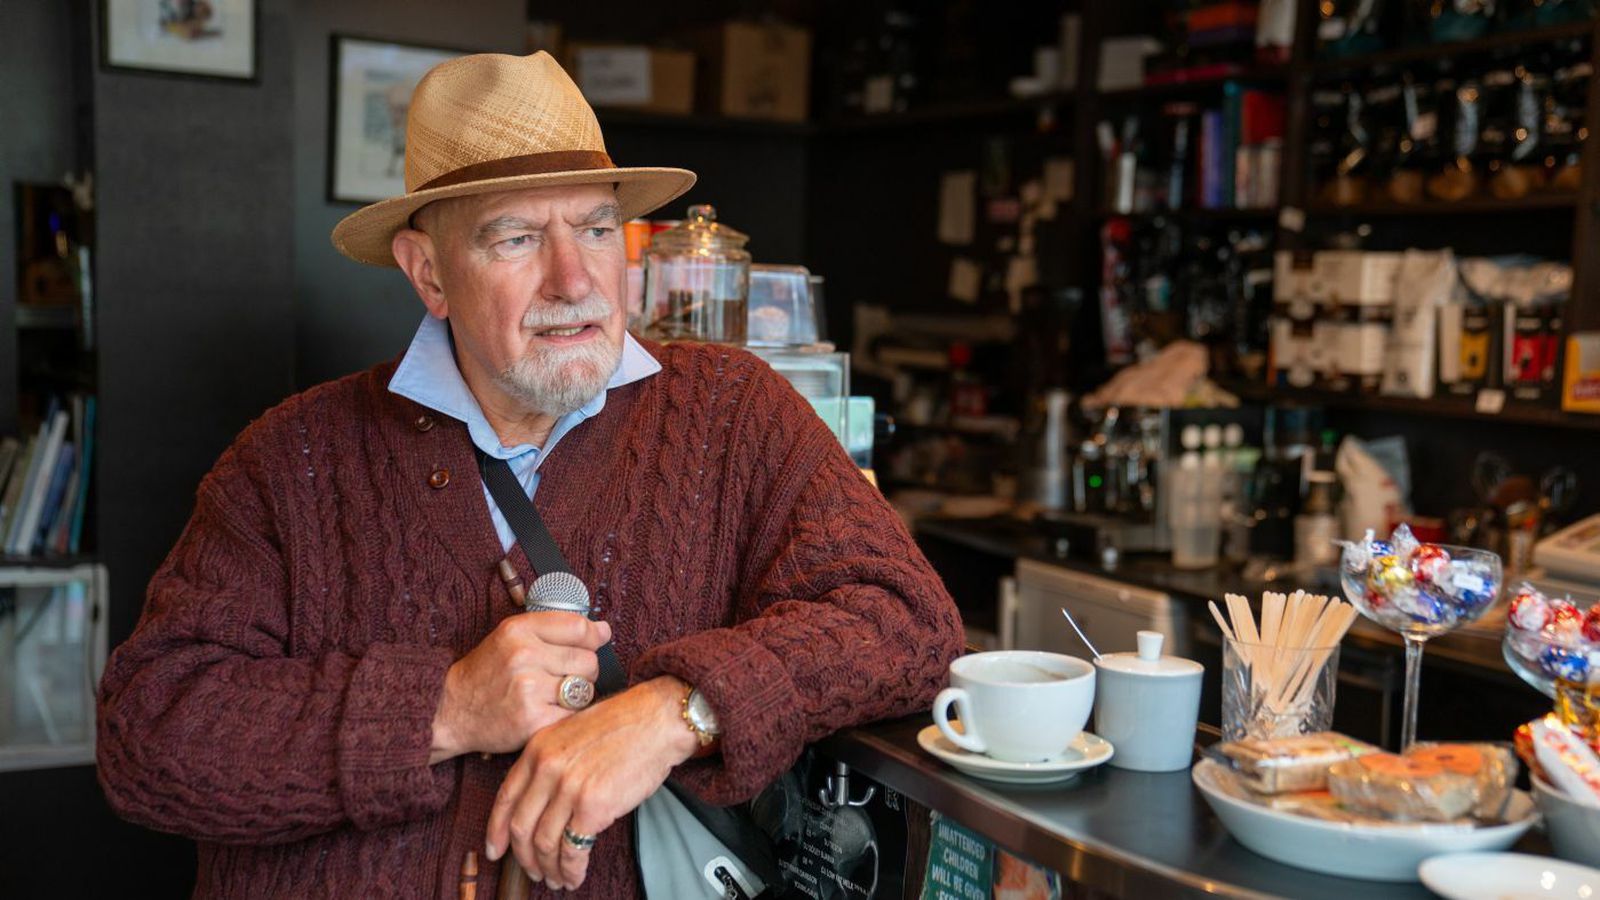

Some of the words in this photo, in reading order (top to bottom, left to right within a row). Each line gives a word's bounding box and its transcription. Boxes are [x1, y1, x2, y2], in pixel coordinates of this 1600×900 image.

[932, 864, 951, 887] WILL
[953, 875, 964, 893] BE
[943, 847, 979, 880] CHILDREN
